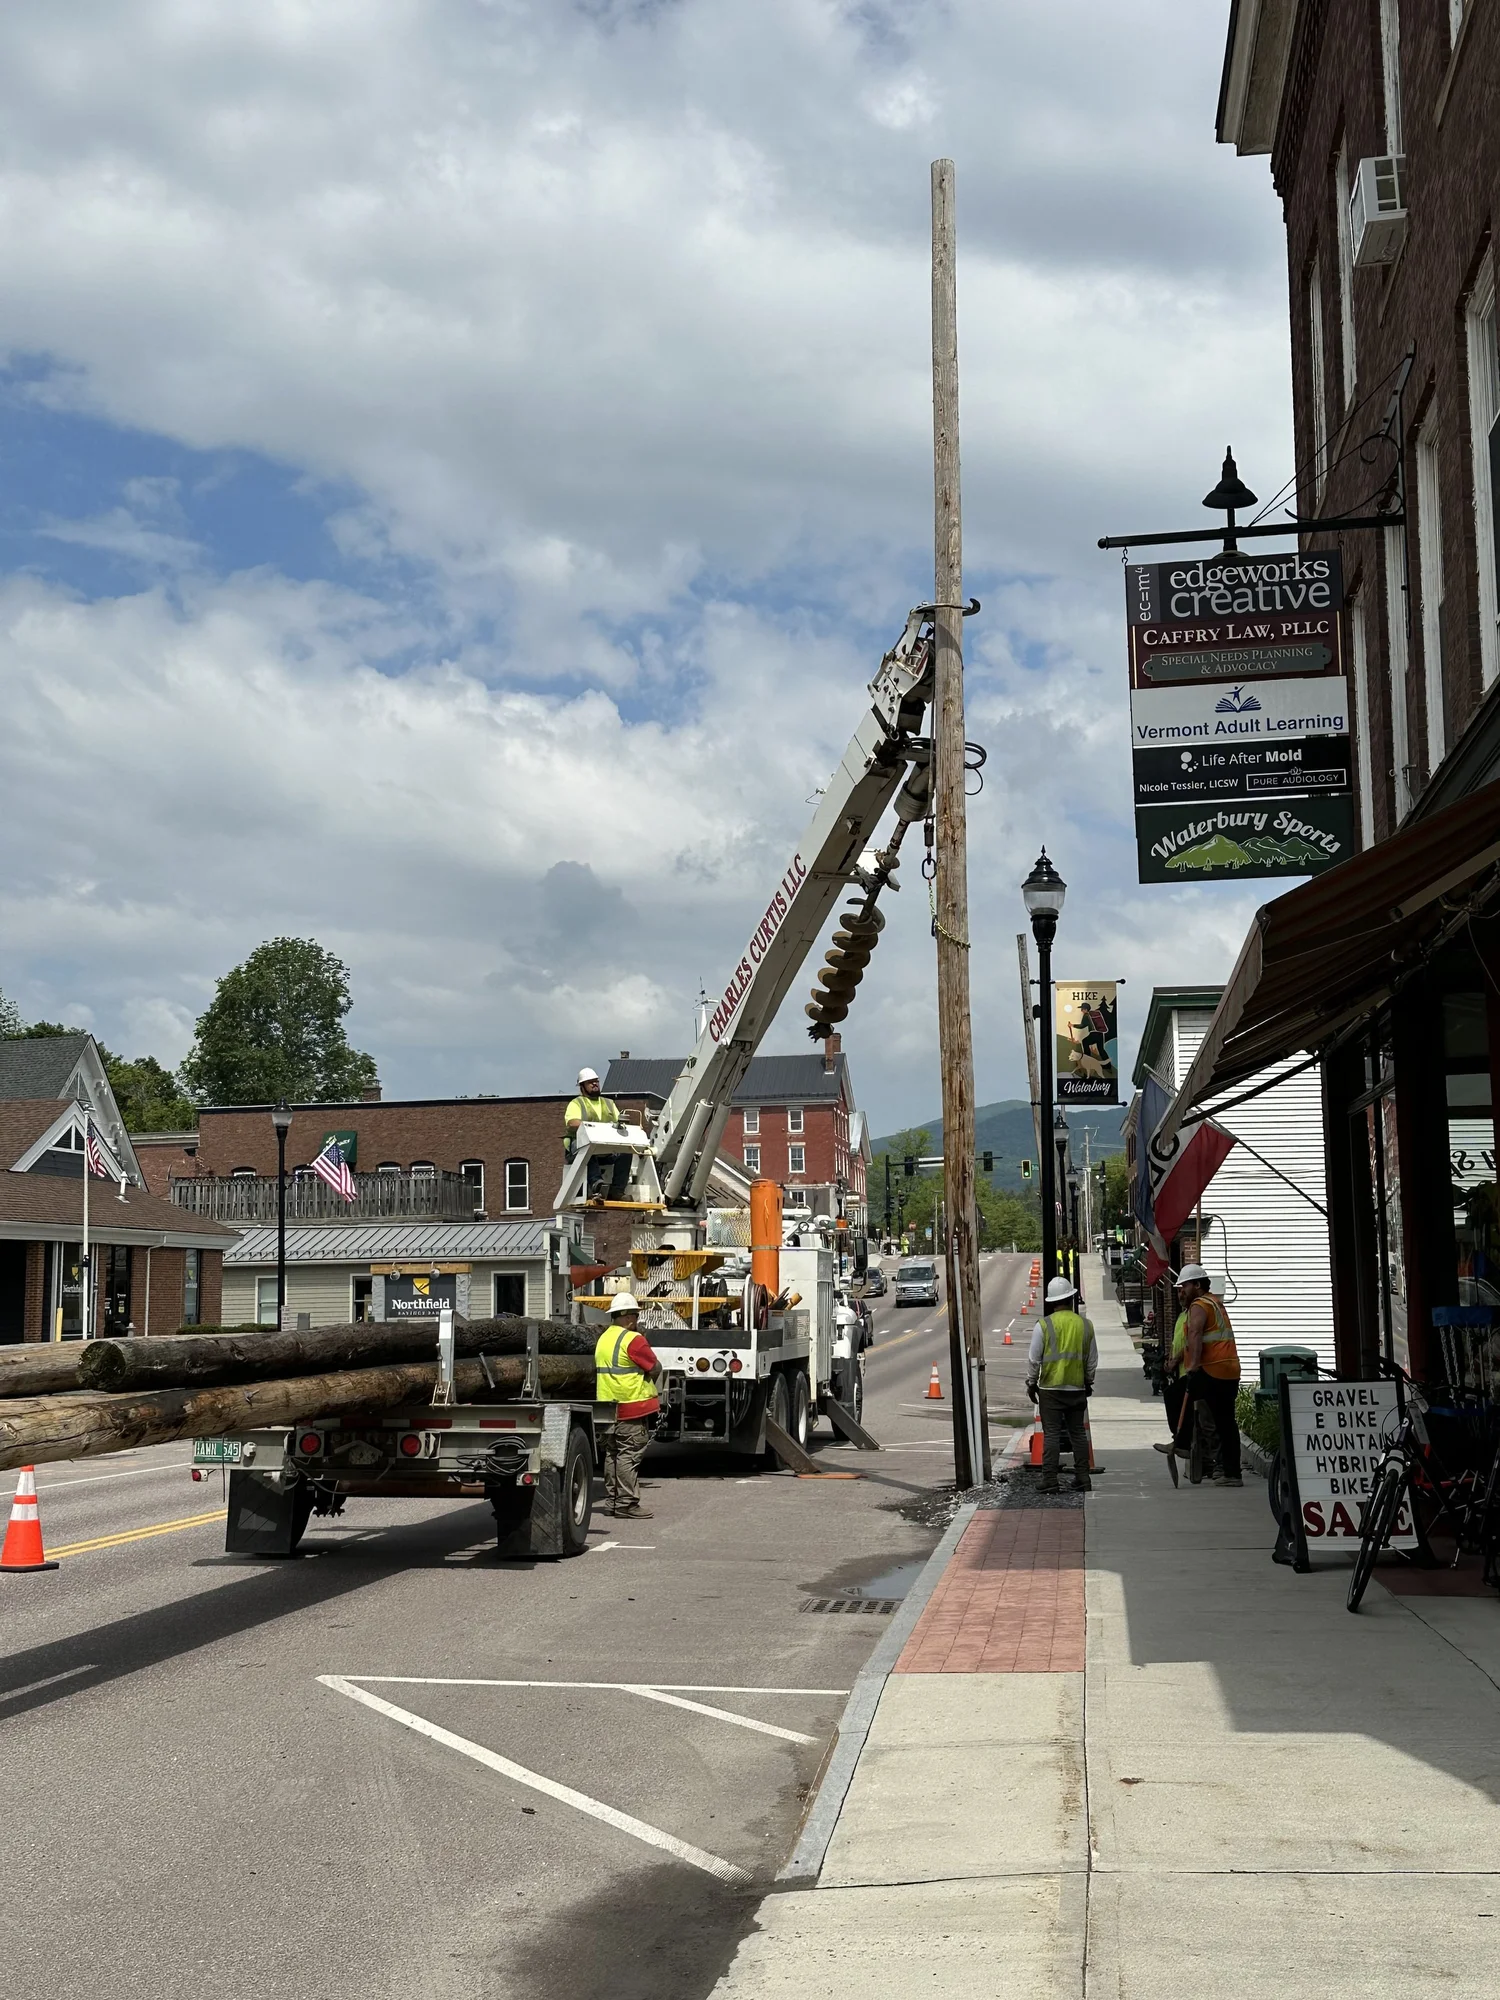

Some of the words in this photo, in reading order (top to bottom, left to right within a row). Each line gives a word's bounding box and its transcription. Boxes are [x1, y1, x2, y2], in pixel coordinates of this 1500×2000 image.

[1169, 555, 1330, 595] edgeworks
[1170, 579, 1331, 619] creative
[1142, 627, 1221, 646] CAFFRY
[1226, 623, 1275, 641] LAW,
[1281, 620, 1330, 637] PLLC
[1161, 654, 1207, 666] SPECIAL
[1210, 651, 1249, 664] NEEDS
[1252, 647, 1313, 660] PLANNING
[1201, 664, 1211, 674] &
[1214, 660, 1278, 674] ADVOCACY
[1137, 723, 1209, 739] Vermont
[1215, 718, 1261, 735] Adult
[1266, 715, 1344, 731] Learning
[1202, 754, 1226, 767] Life
[1229, 751, 1262, 765] After
[1265, 749, 1302, 763] Mold
[1139, 782, 1169, 793] Nicole
[1209, 778, 1239, 788] LICSW
[1253, 777, 1279, 786] PURE
[1282, 774, 1339, 784] AUDIOLOGY
[1150, 810, 1269, 859] Waterbury
[1272, 810, 1342, 854] Sports
[709, 956, 753, 1043] CHARLES
[749, 890, 788, 965] CURTIS
[781, 853, 807, 901] LLC
[1072, 991, 1098, 1001] HIKE
[391, 1298, 451, 1310] Northfield
[1312, 1388, 1380, 1407] GRAVEL
[1316, 1412, 1325, 1429] E
[1337, 1411, 1378, 1428] BIKE
[1306, 1432, 1395, 1451] MOUNTAIN
[1316, 1455, 1380, 1474] HYBRID
[1330, 1477, 1370, 1495] BIKE
